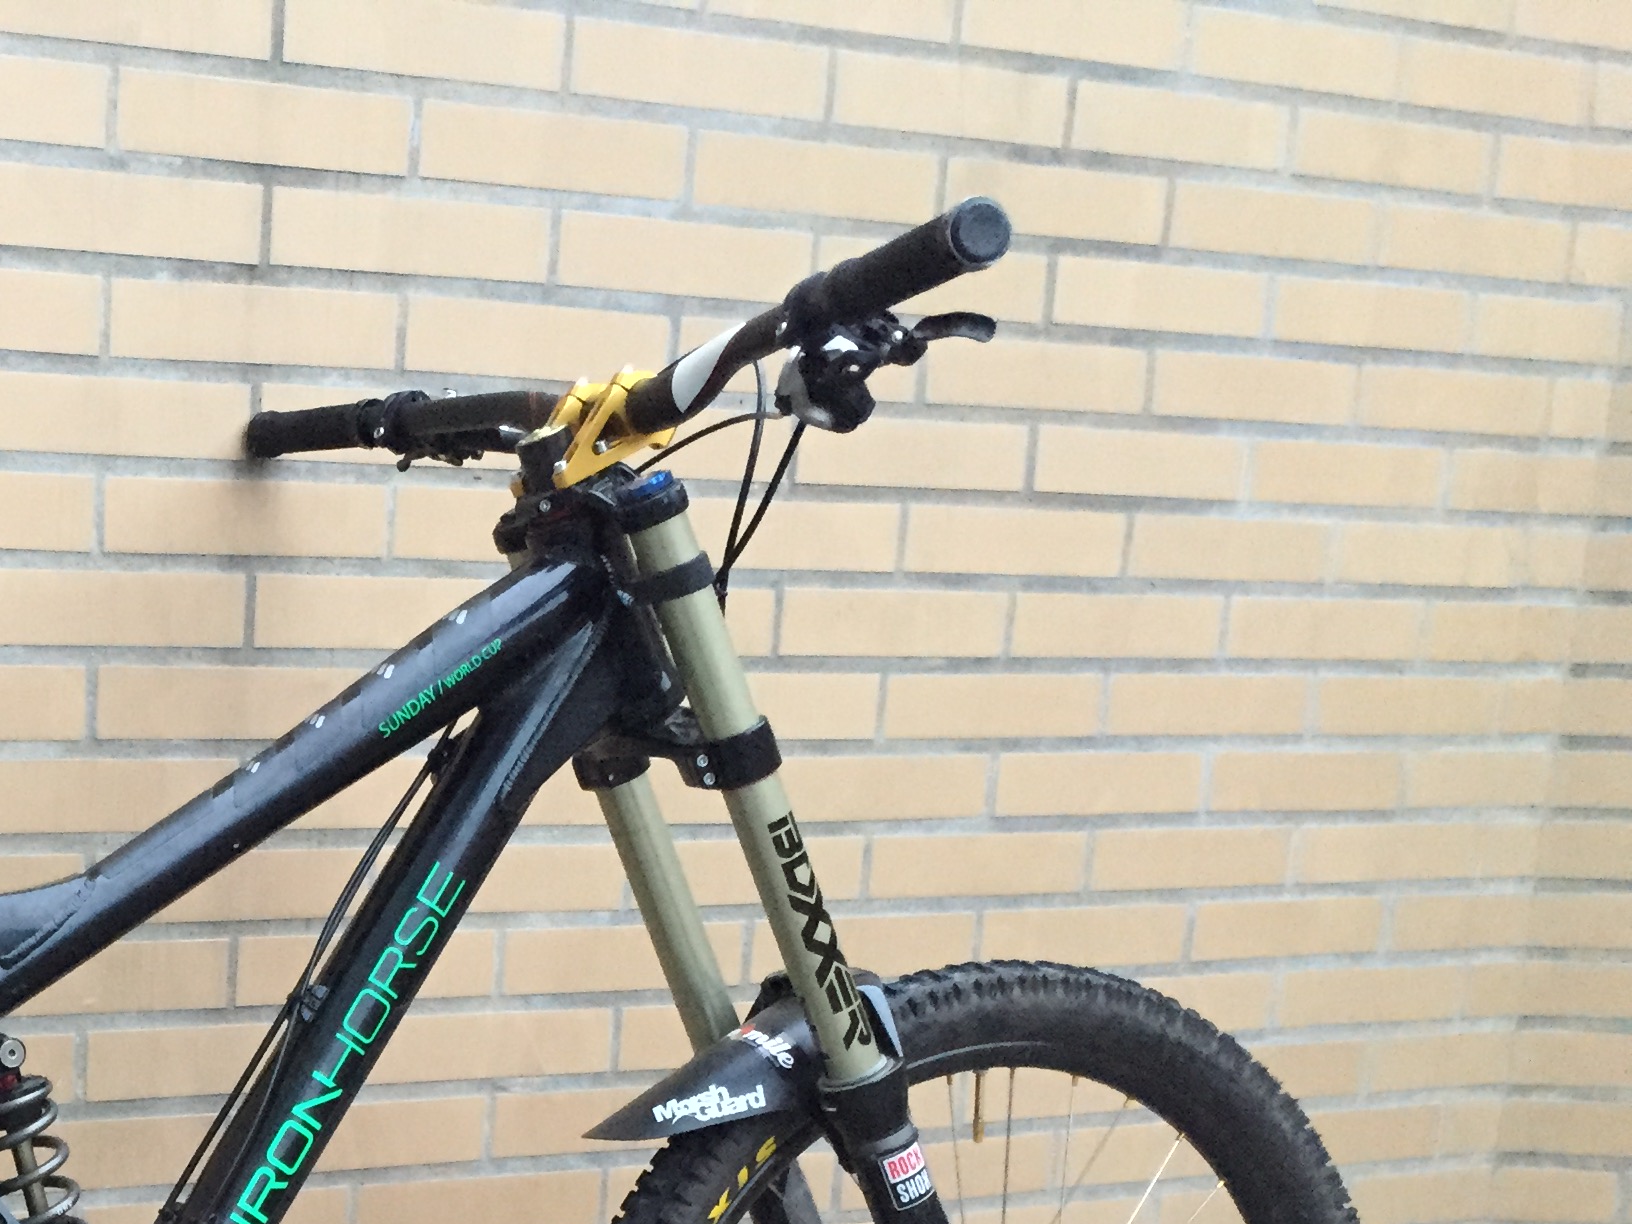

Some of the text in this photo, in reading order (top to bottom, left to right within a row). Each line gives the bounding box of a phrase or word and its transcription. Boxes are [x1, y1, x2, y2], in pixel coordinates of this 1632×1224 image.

[378, 684, 436, 738] SUNDAY
[767, 810, 872, 1052] BOXXER
[695, 1084, 767, 1122] Guard
[887, 1147, 924, 1180] ROCK
